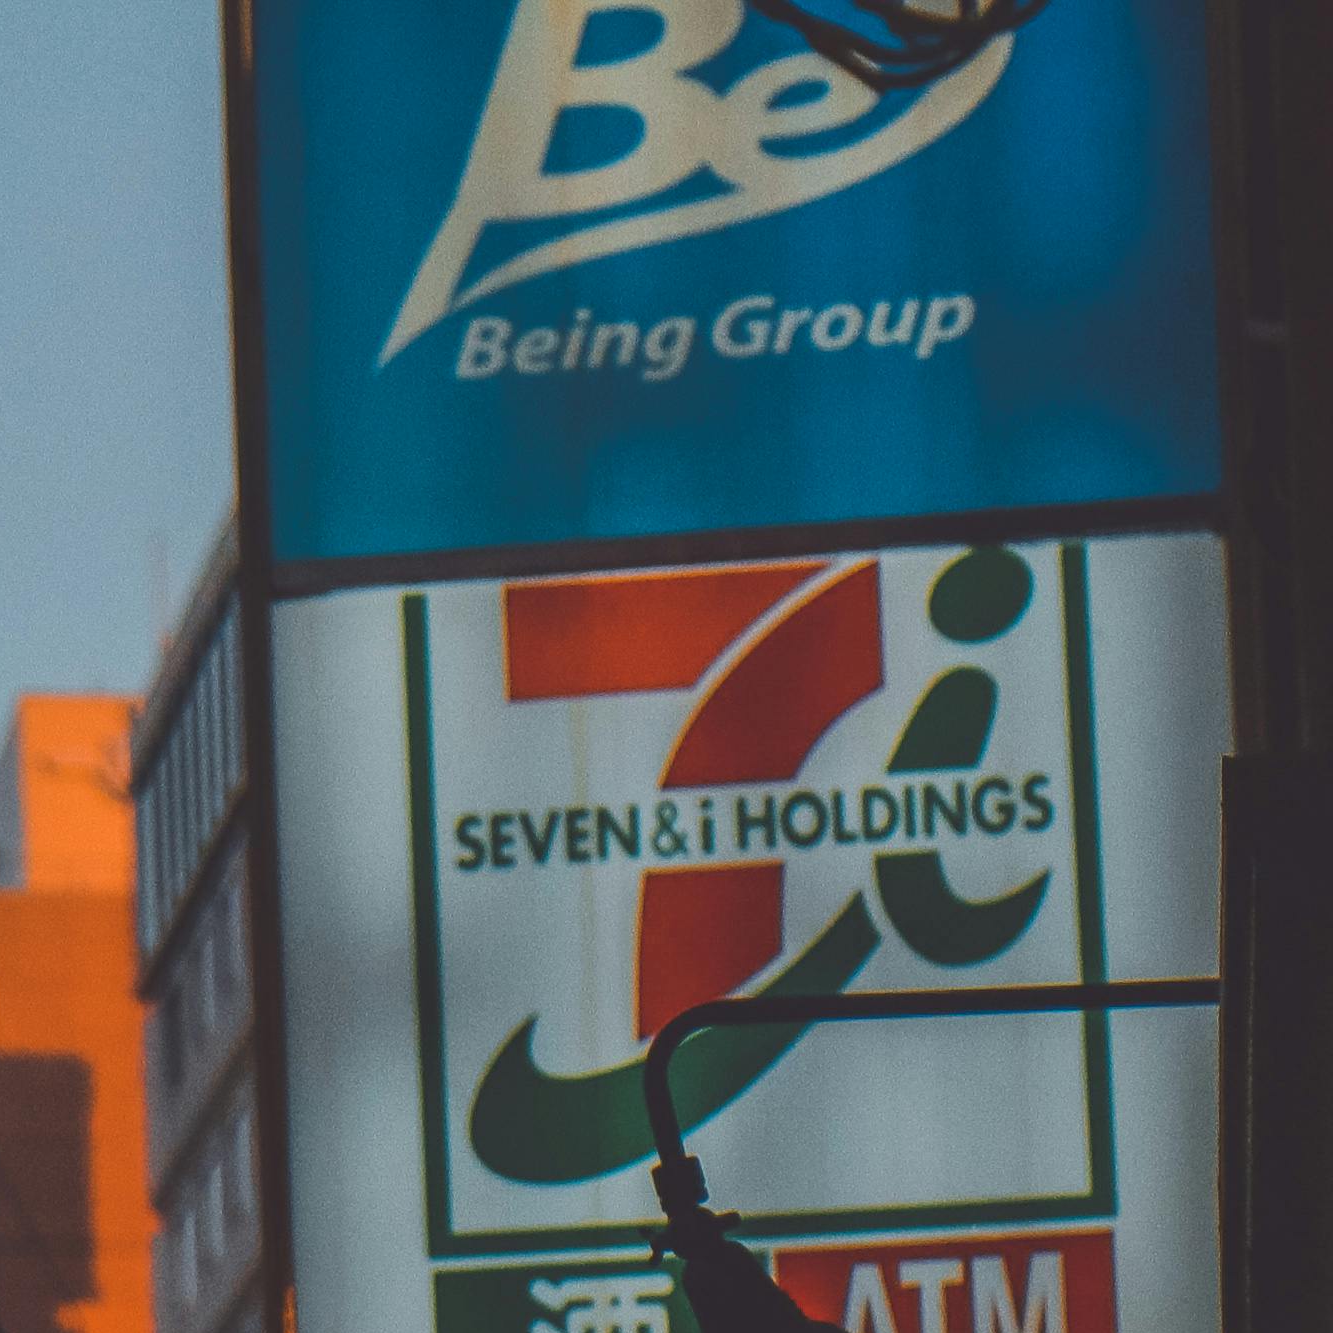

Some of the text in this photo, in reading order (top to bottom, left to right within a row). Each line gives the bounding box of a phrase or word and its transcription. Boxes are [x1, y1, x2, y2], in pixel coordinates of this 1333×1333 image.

[454, 293, 977, 382] Being Group
[735, 774, 1054, 850] HOLDINGS
